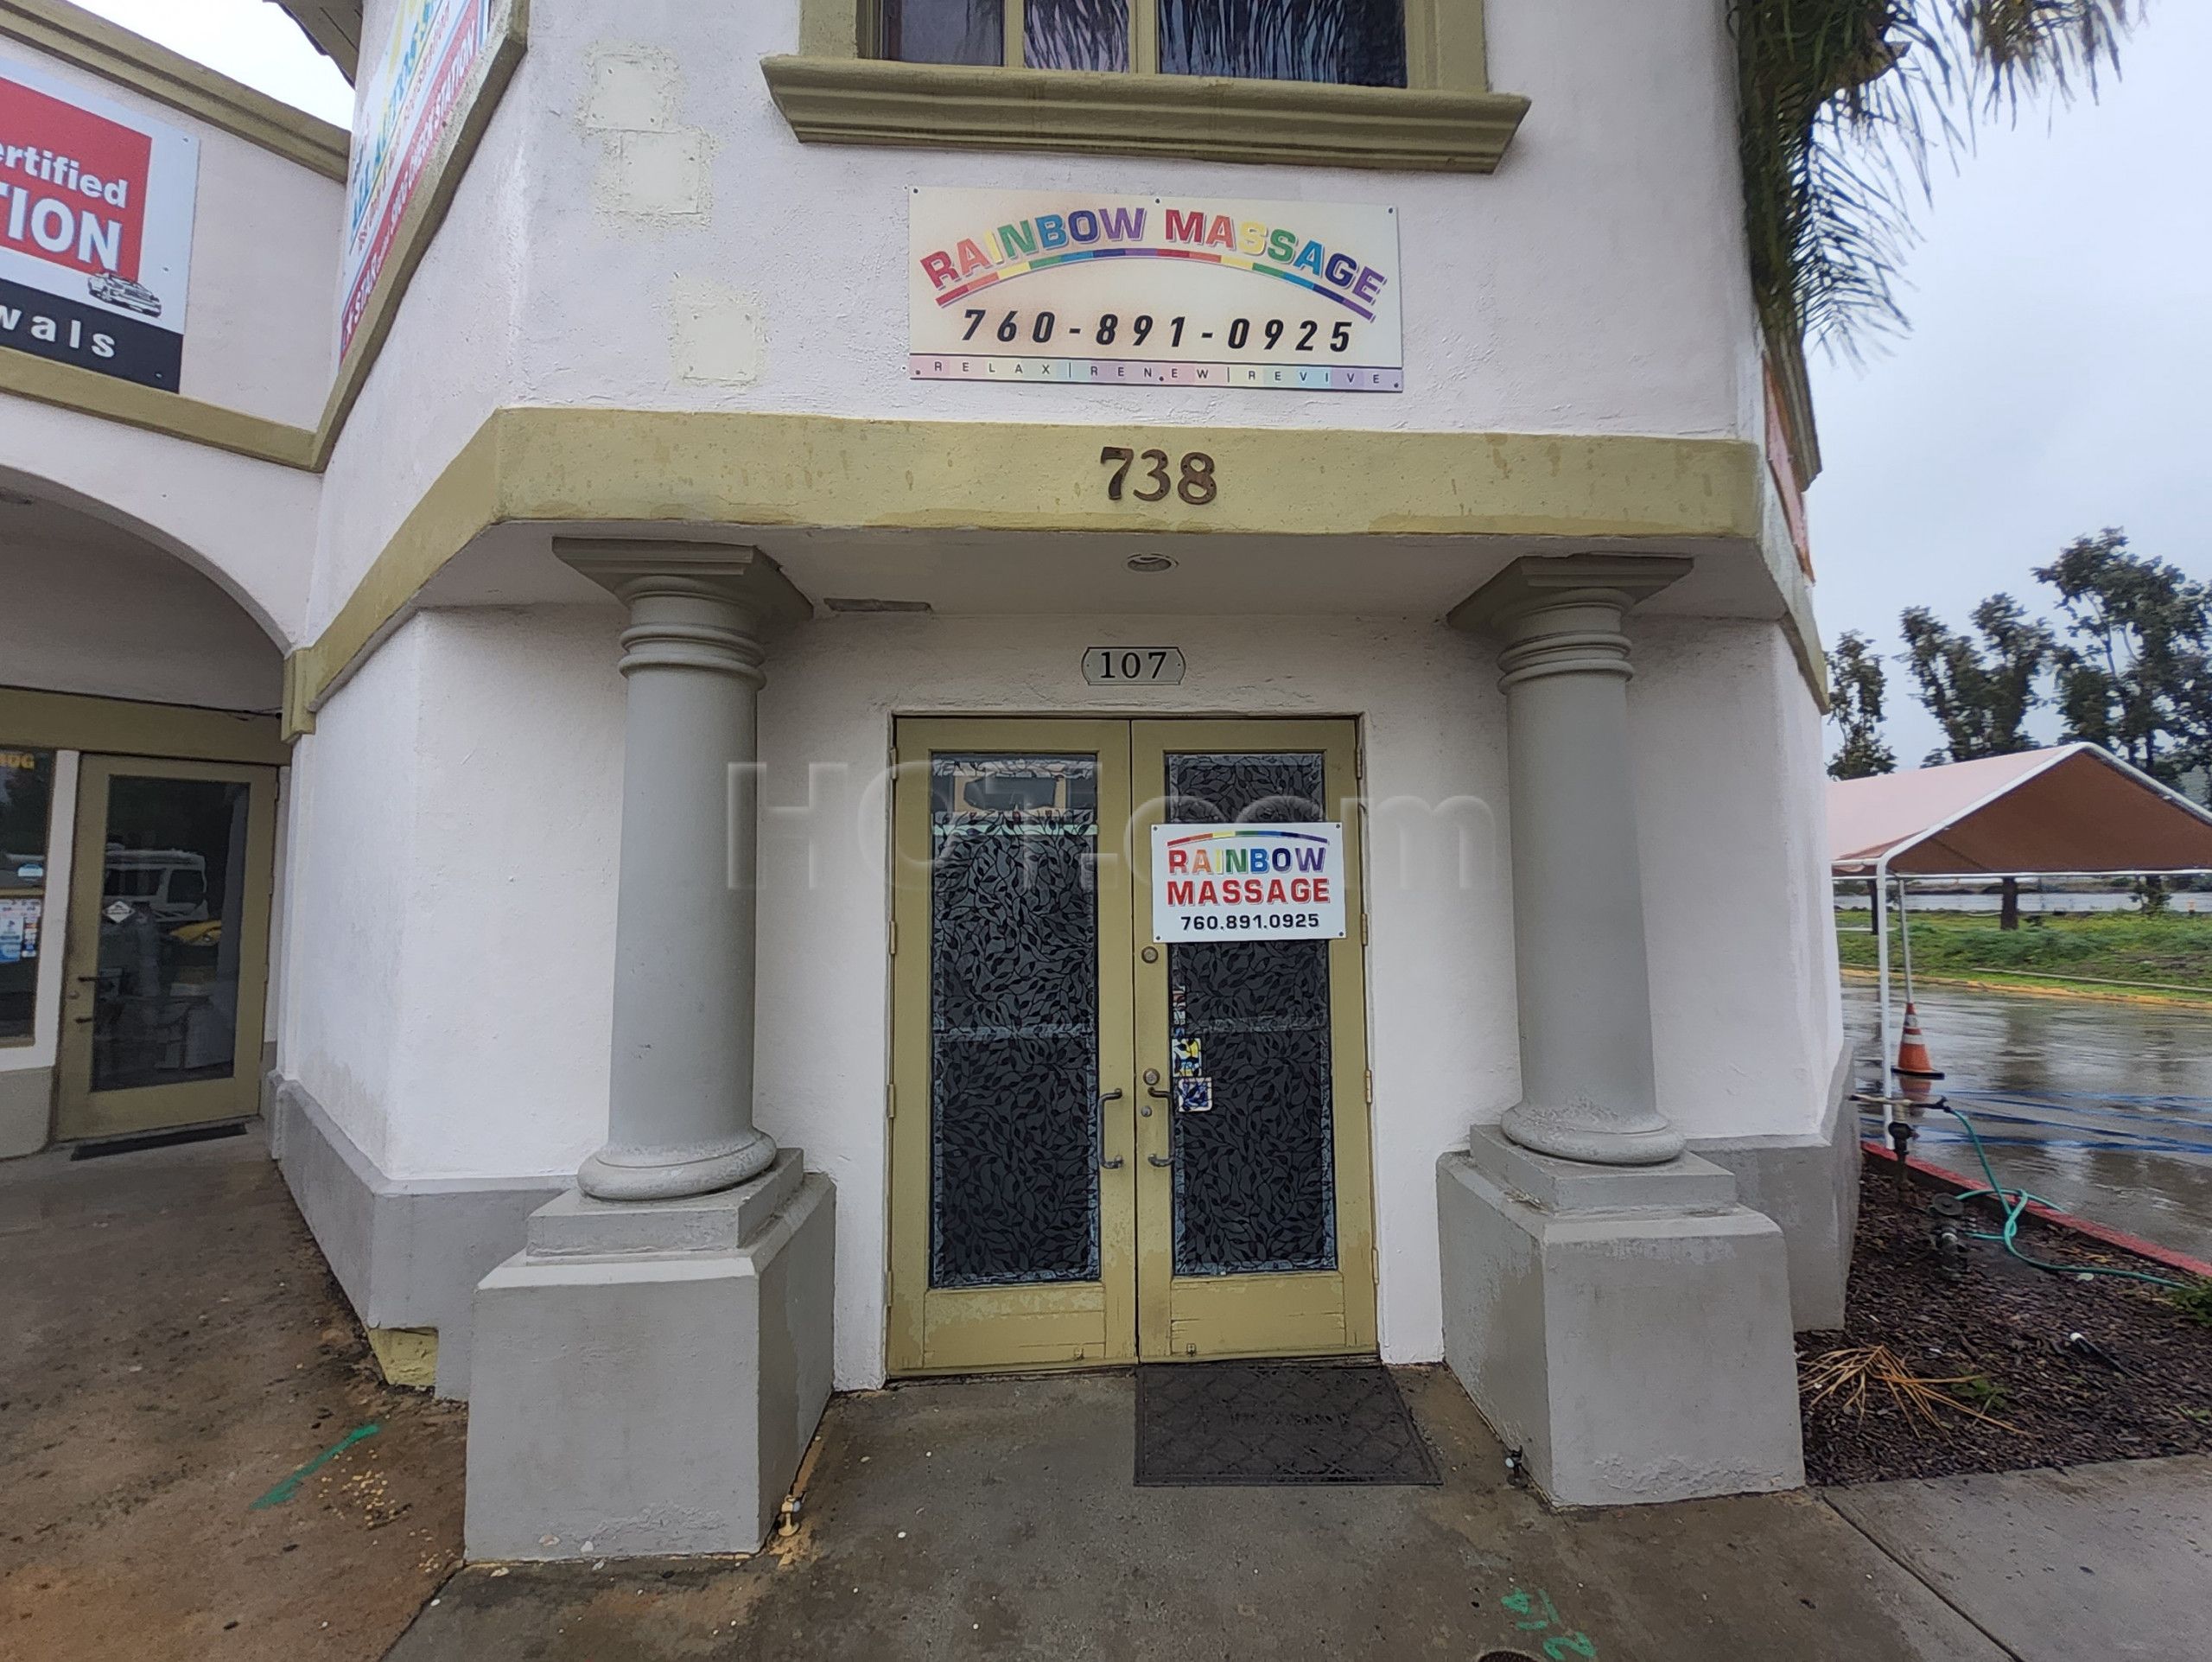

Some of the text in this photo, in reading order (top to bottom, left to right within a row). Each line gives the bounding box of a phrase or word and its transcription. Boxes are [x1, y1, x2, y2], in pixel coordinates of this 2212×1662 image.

[0, 142, 128, 208] rtified
[919, 207, 1387, 305] RAINBOW MASSAGE
[962, 309, 1352, 353] 760-891-0925
[1099, 446, 1217, 505] 738
[1099, 651, 1168, 679] 107
[1167, 848, 1327, 875] RAINBOW
[1167, 878, 1332, 907] MASSAGE
[1180, 913, 1320, 932] 760.891.0925
